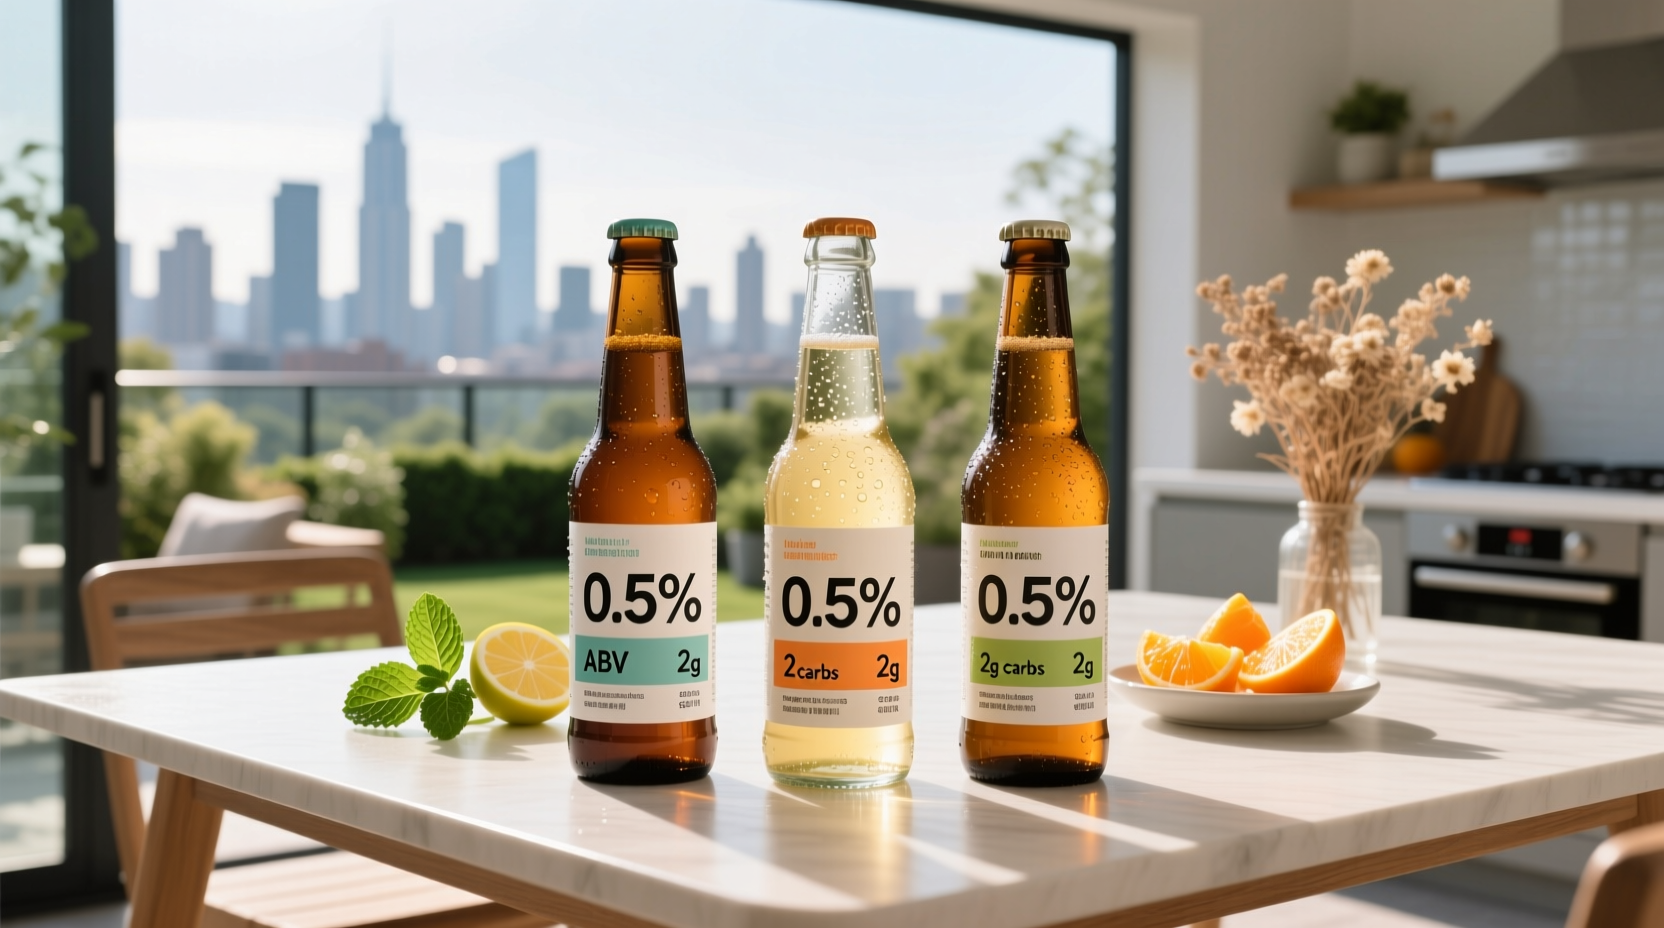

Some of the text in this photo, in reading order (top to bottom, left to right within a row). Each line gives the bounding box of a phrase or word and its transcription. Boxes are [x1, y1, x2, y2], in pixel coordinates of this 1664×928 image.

[583, 572, 702, 624] 0.5%
[782, 576, 901, 628] 0.5%
[978, 574, 1096, 626] 0.5%
[583, 648, 701, 677] ABV 2g
[876, 653, 900, 683] 2g
[980, 651, 1094, 679] 2g carbs 2g
